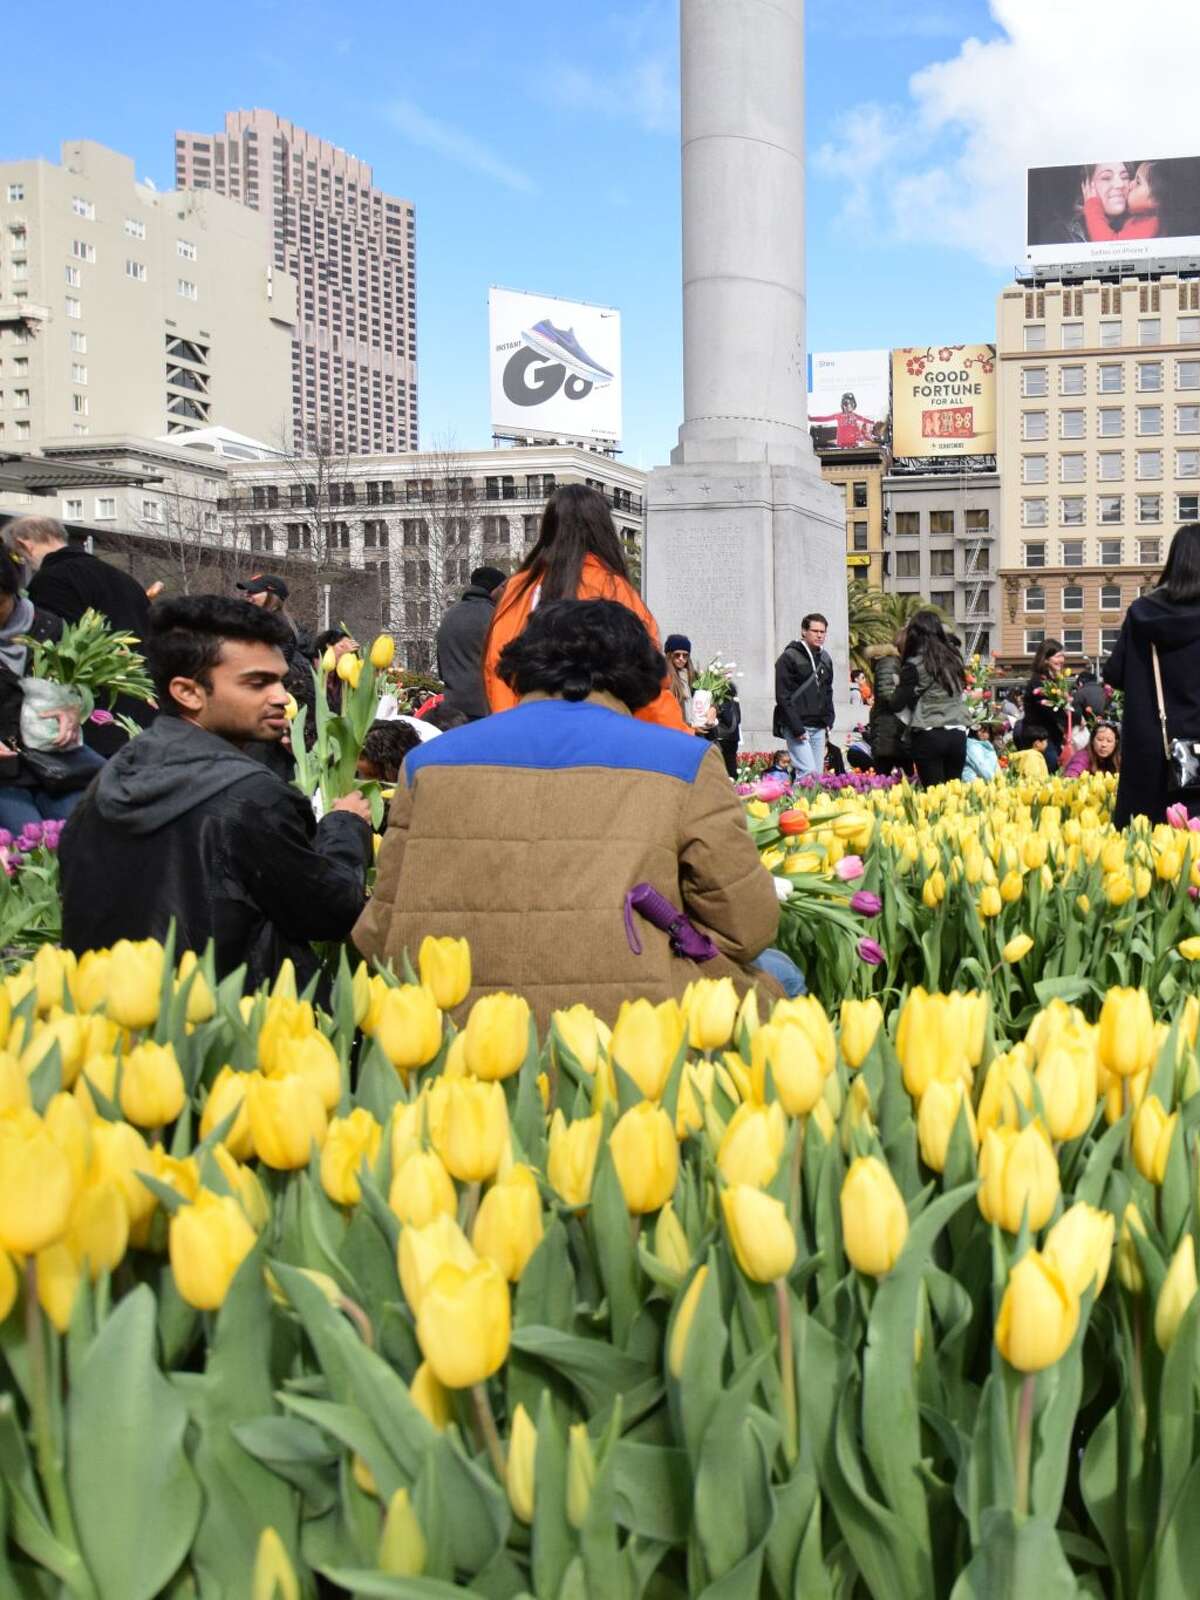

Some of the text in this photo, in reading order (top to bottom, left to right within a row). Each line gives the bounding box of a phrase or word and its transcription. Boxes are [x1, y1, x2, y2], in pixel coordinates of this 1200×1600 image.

[496, 340, 521, 352] INSTANT
[924, 370, 969, 383] GOOD
[913, 383, 982, 397] FORTUNE
[931, 397, 964, 406] FOR ALL
